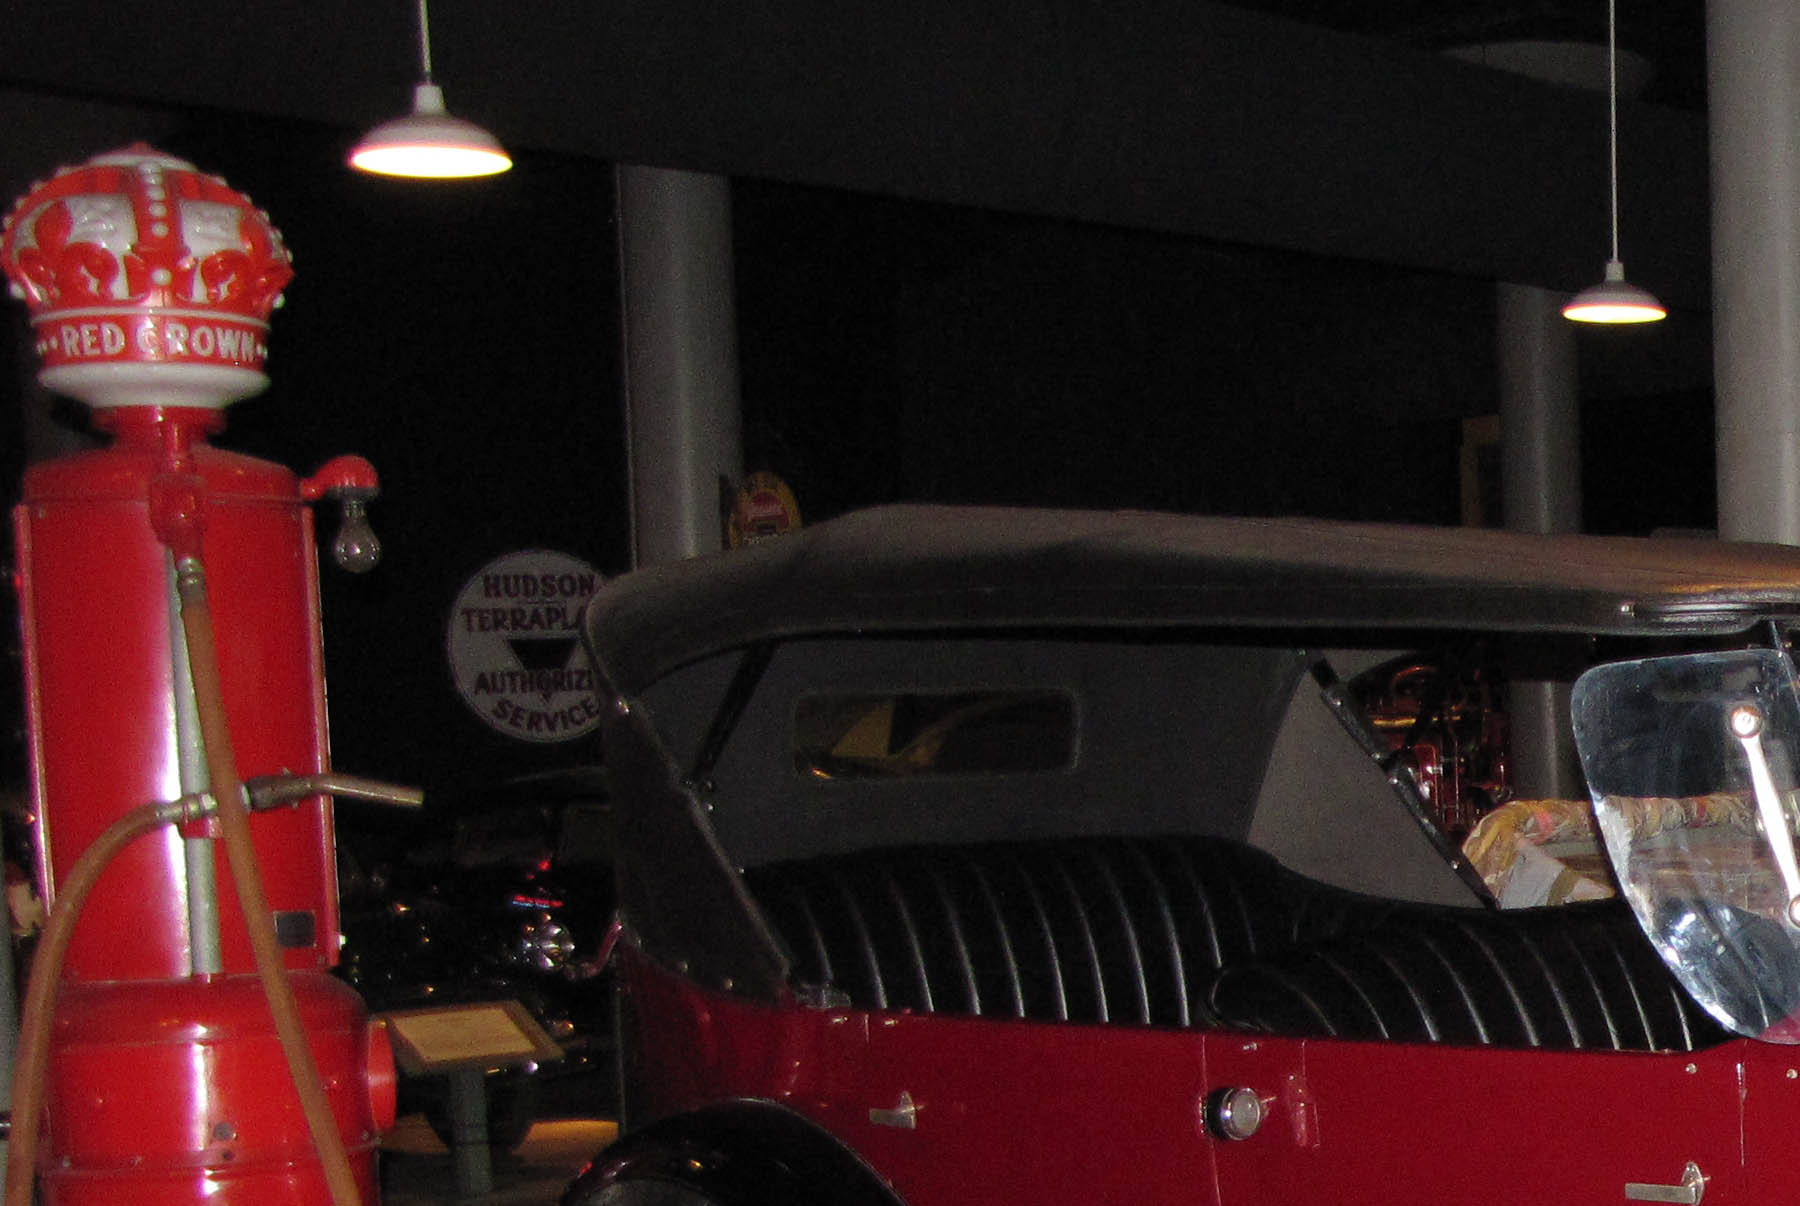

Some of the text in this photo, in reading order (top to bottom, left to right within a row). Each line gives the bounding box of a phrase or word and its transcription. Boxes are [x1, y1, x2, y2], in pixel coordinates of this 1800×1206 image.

[61, 322, 257, 363] RED CROWN
[483, 573, 597, 598] HUDSON
[461, 606, 585, 632] TERRAPL
[474, 669, 593, 695] AUTHORIZ
[492, 697, 600, 732] SERVICE
